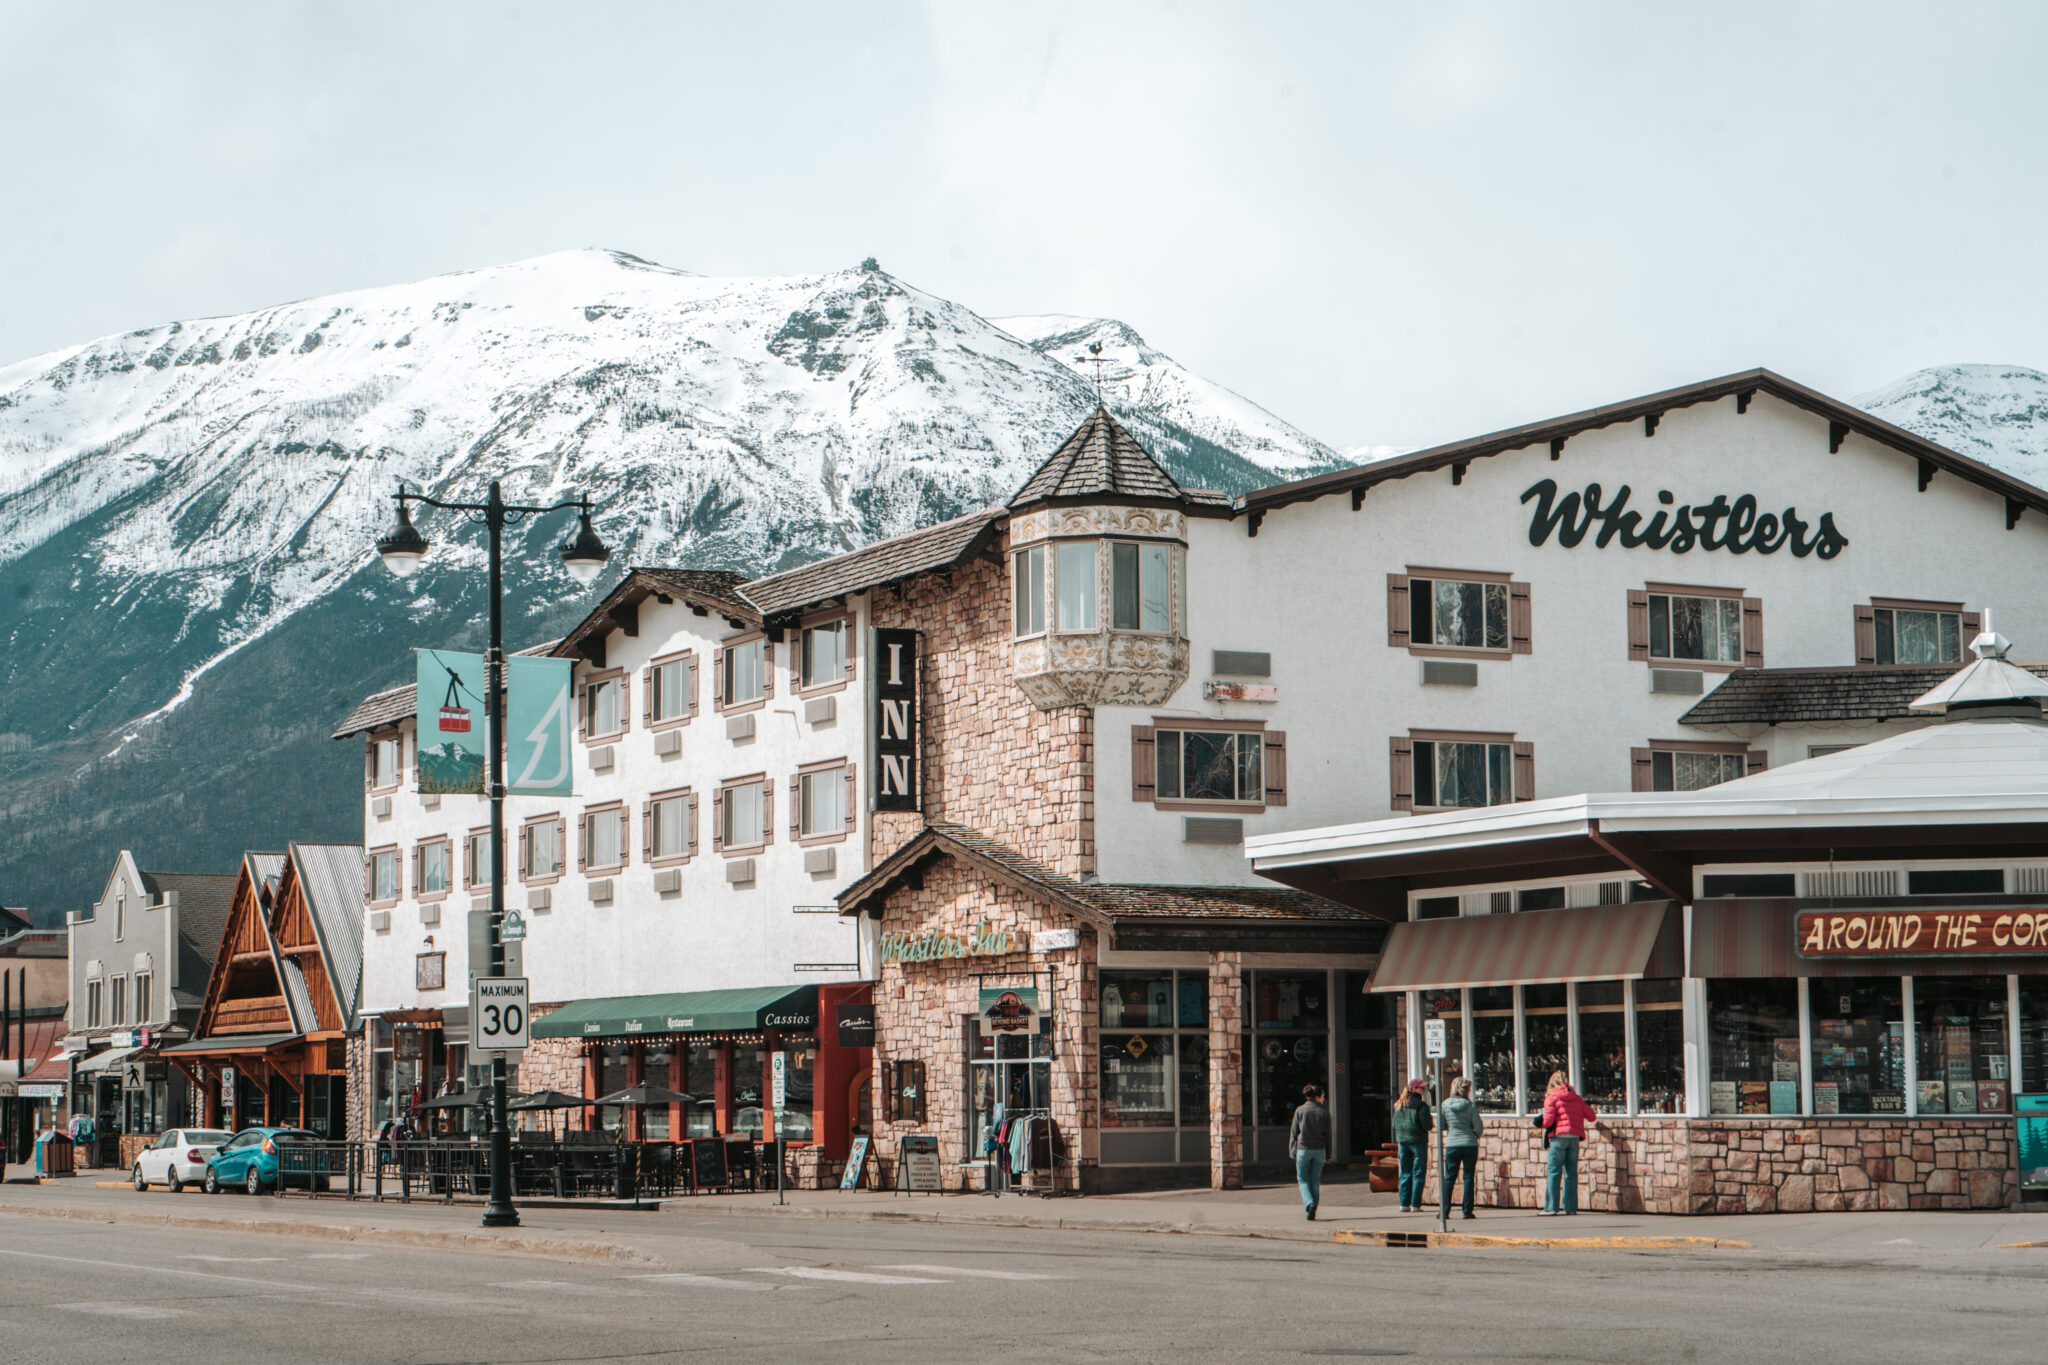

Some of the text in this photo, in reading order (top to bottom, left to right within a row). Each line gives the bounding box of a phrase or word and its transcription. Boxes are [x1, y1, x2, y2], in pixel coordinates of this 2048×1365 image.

[1520, 478, 1849, 560] Whistlers
[880, 643, 911, 796] INN
[878, 920, 1009, 964] Whistlers Inn
[1803, 913, 2048, 951] AROUND THE COR
[481, 985, 524, 997] MAXIMUM
[1434, 1000, 1456, 1010] OPEN
[483, 1004, 523, 1036] 30
[624, 1019, 643, 1032] Italian
[765, 1012, 810, 1026] Cassios
